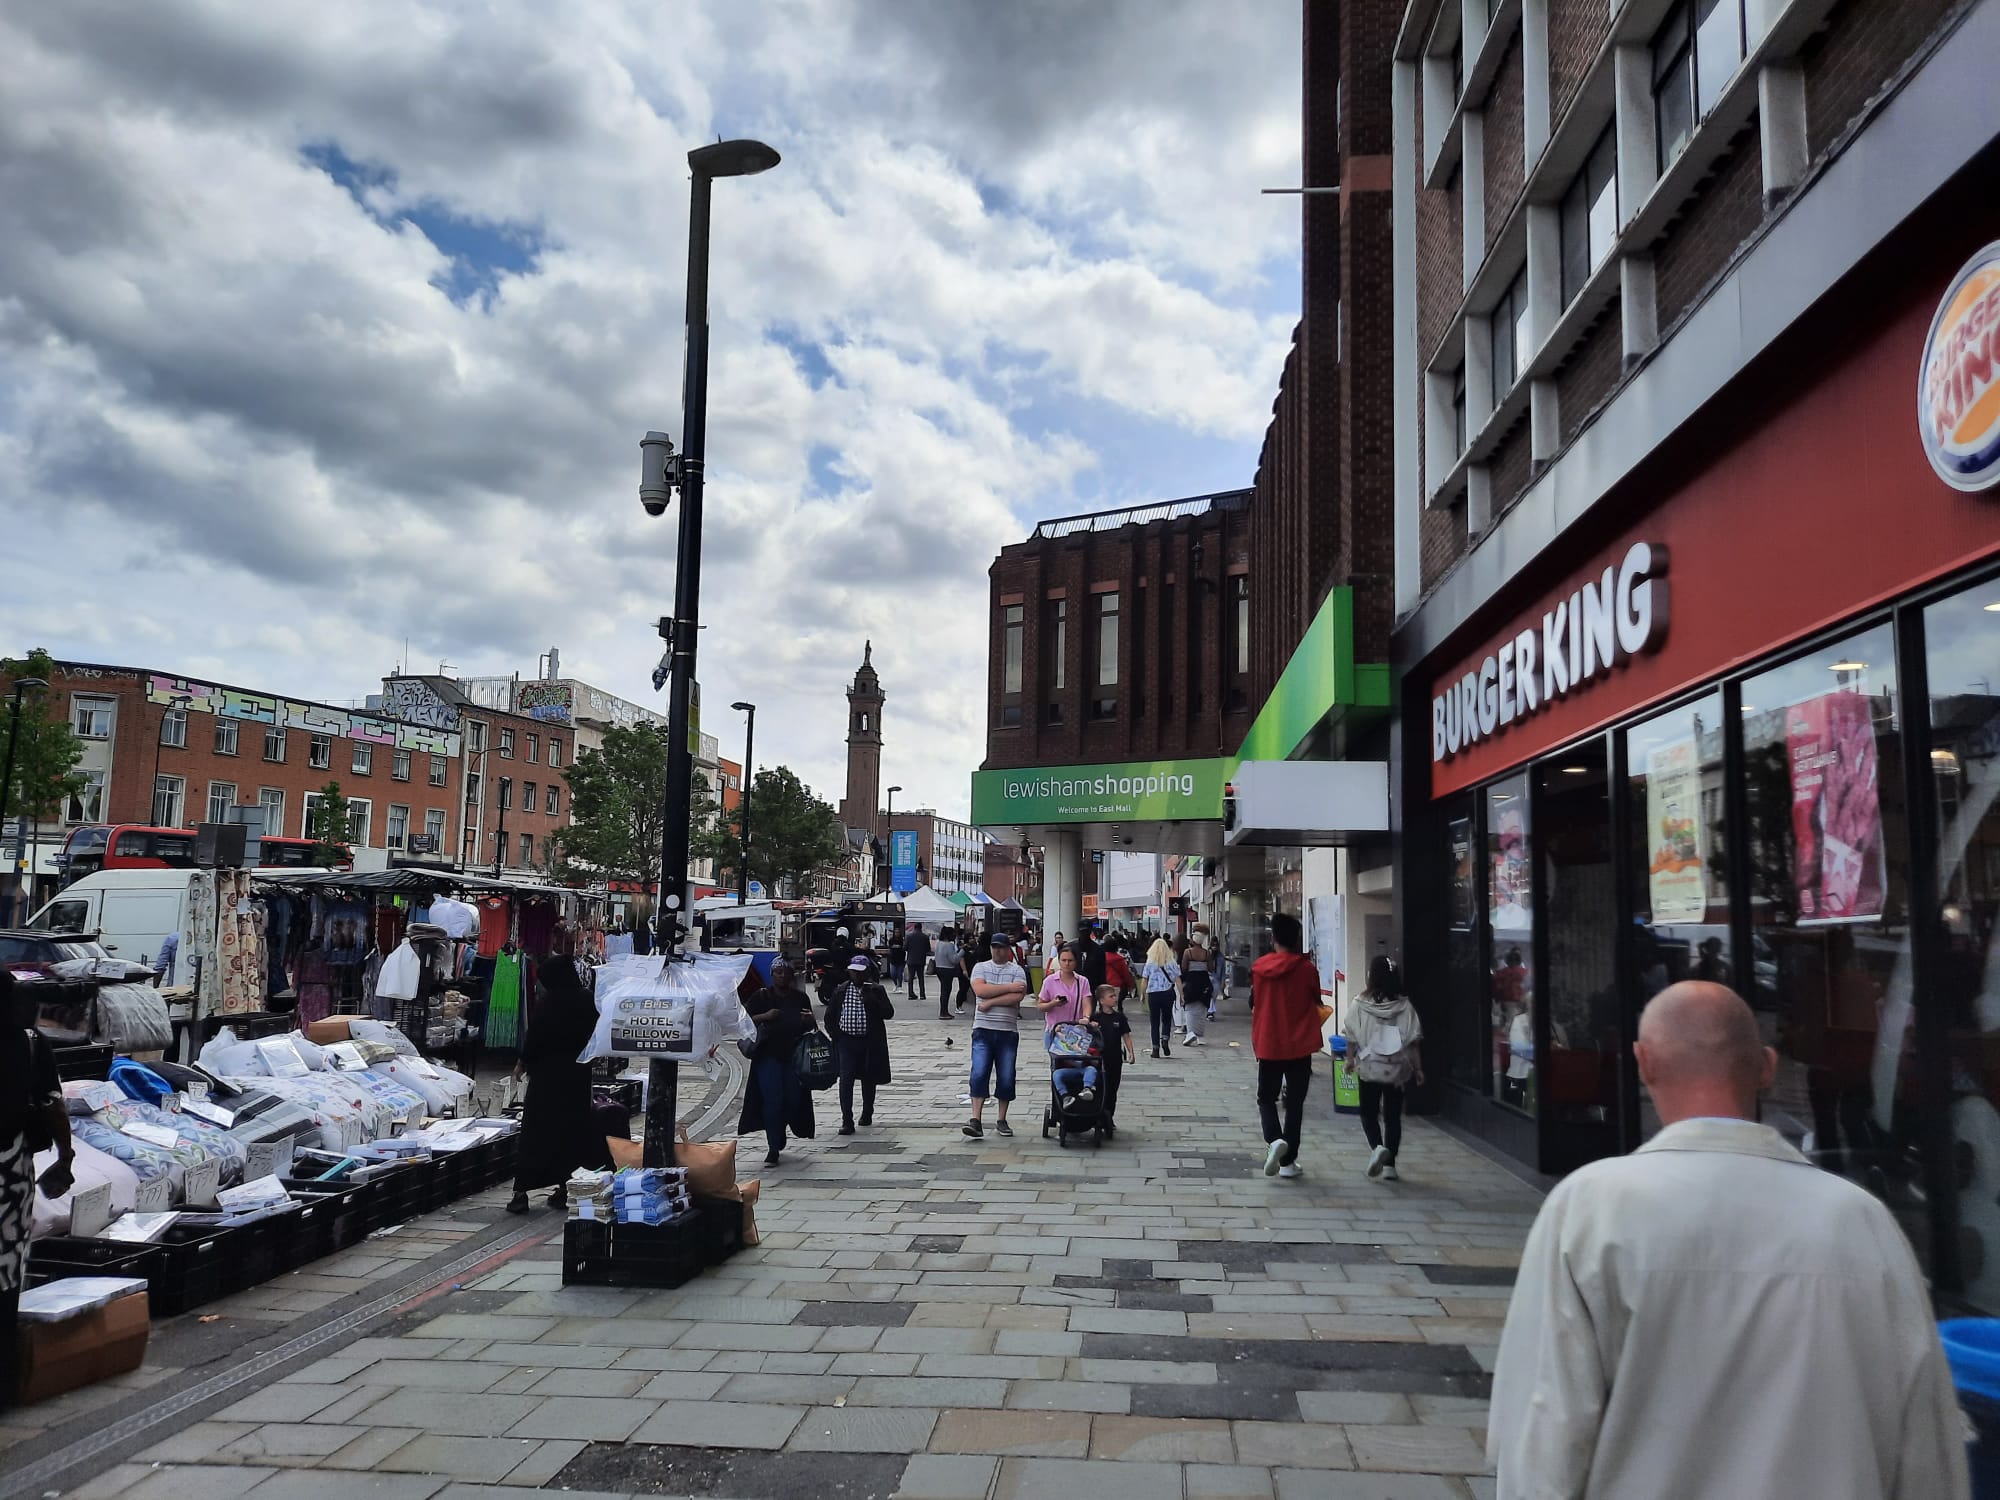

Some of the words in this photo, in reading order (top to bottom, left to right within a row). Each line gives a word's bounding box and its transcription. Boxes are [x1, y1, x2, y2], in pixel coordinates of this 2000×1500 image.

[1432, 628, 1538, 762] BURGER
[1542, 542, 1653, 701] KING
[1058, 805, 1089, 814] Welcome
[1099, 805, 1114, 813] East
[1116, 804, 1131, 813] Mall
[630, 1016, 674, 1026] HOTEL
[622, 1029, 680, 1039] PILLOWS
